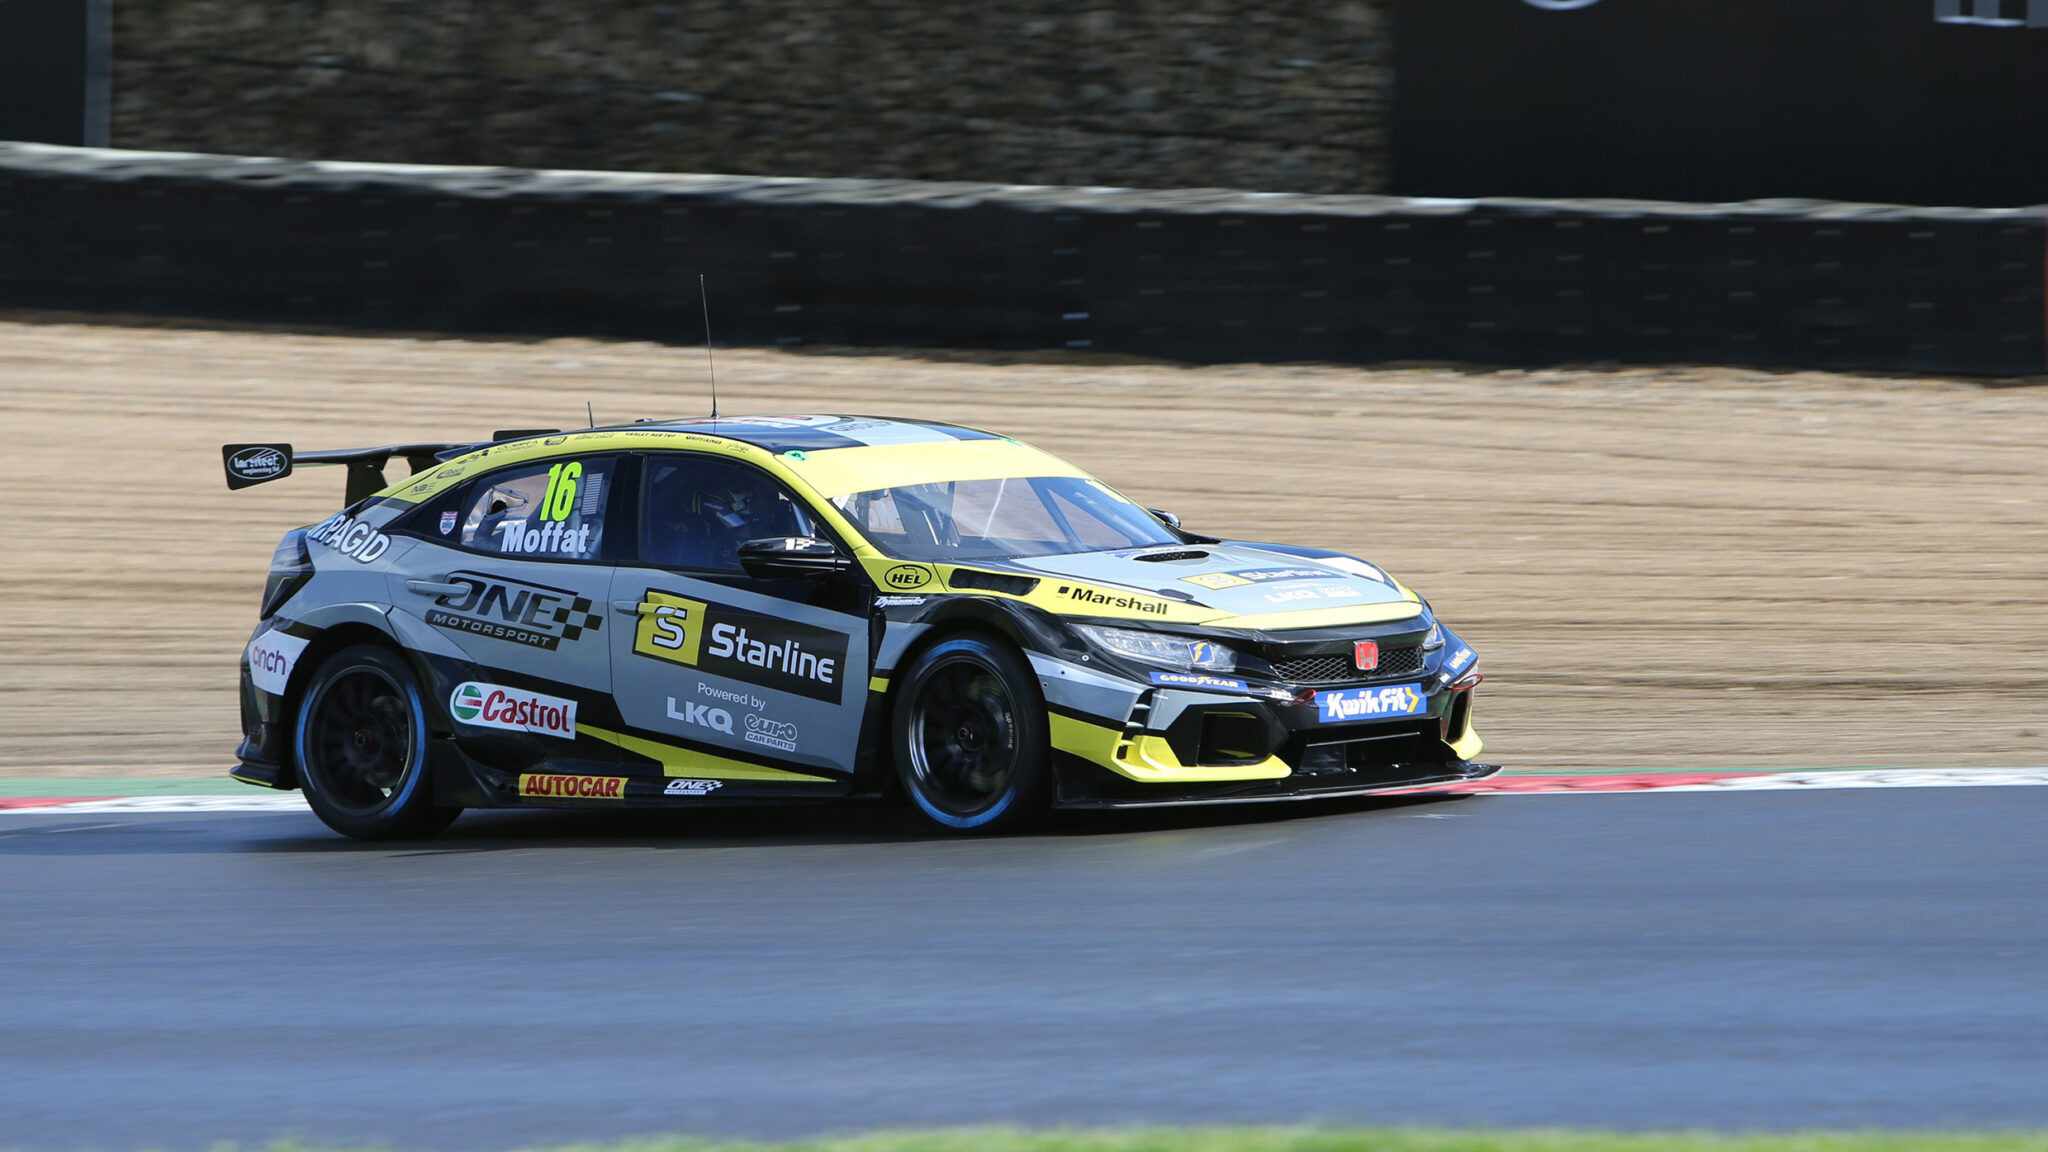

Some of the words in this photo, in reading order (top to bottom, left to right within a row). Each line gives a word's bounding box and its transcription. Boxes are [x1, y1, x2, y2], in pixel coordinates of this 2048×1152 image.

[540, 462, 582, 521] 16
[501, 521, 590, 553] Moffat
[891, 573, 922, 585] HEL
[435, 577, 562, 630] ONE
[1071, 588, 1168, 615] Marshall
[433, 614, 550, 646] MOTORSPORT
[652, 606, 688, 650] S
[708, 622, 835, 684] Starline
[253, 645, 286, 676] cinch
[1160, 674, 1238, 688] GOODYEAR
[482, 690, 570, 733] Castrol
[697, 682, 748, 705] Powered
[751, 695, 766, 712] by
[667, 696, 735, 736] LKQ
[746, 732, 765, 744] CAR
[766, 737, 795, 751] PARTS
[525, 775, 621, 797] AUTOCAR
[666, 780, 709, 790] ONE
